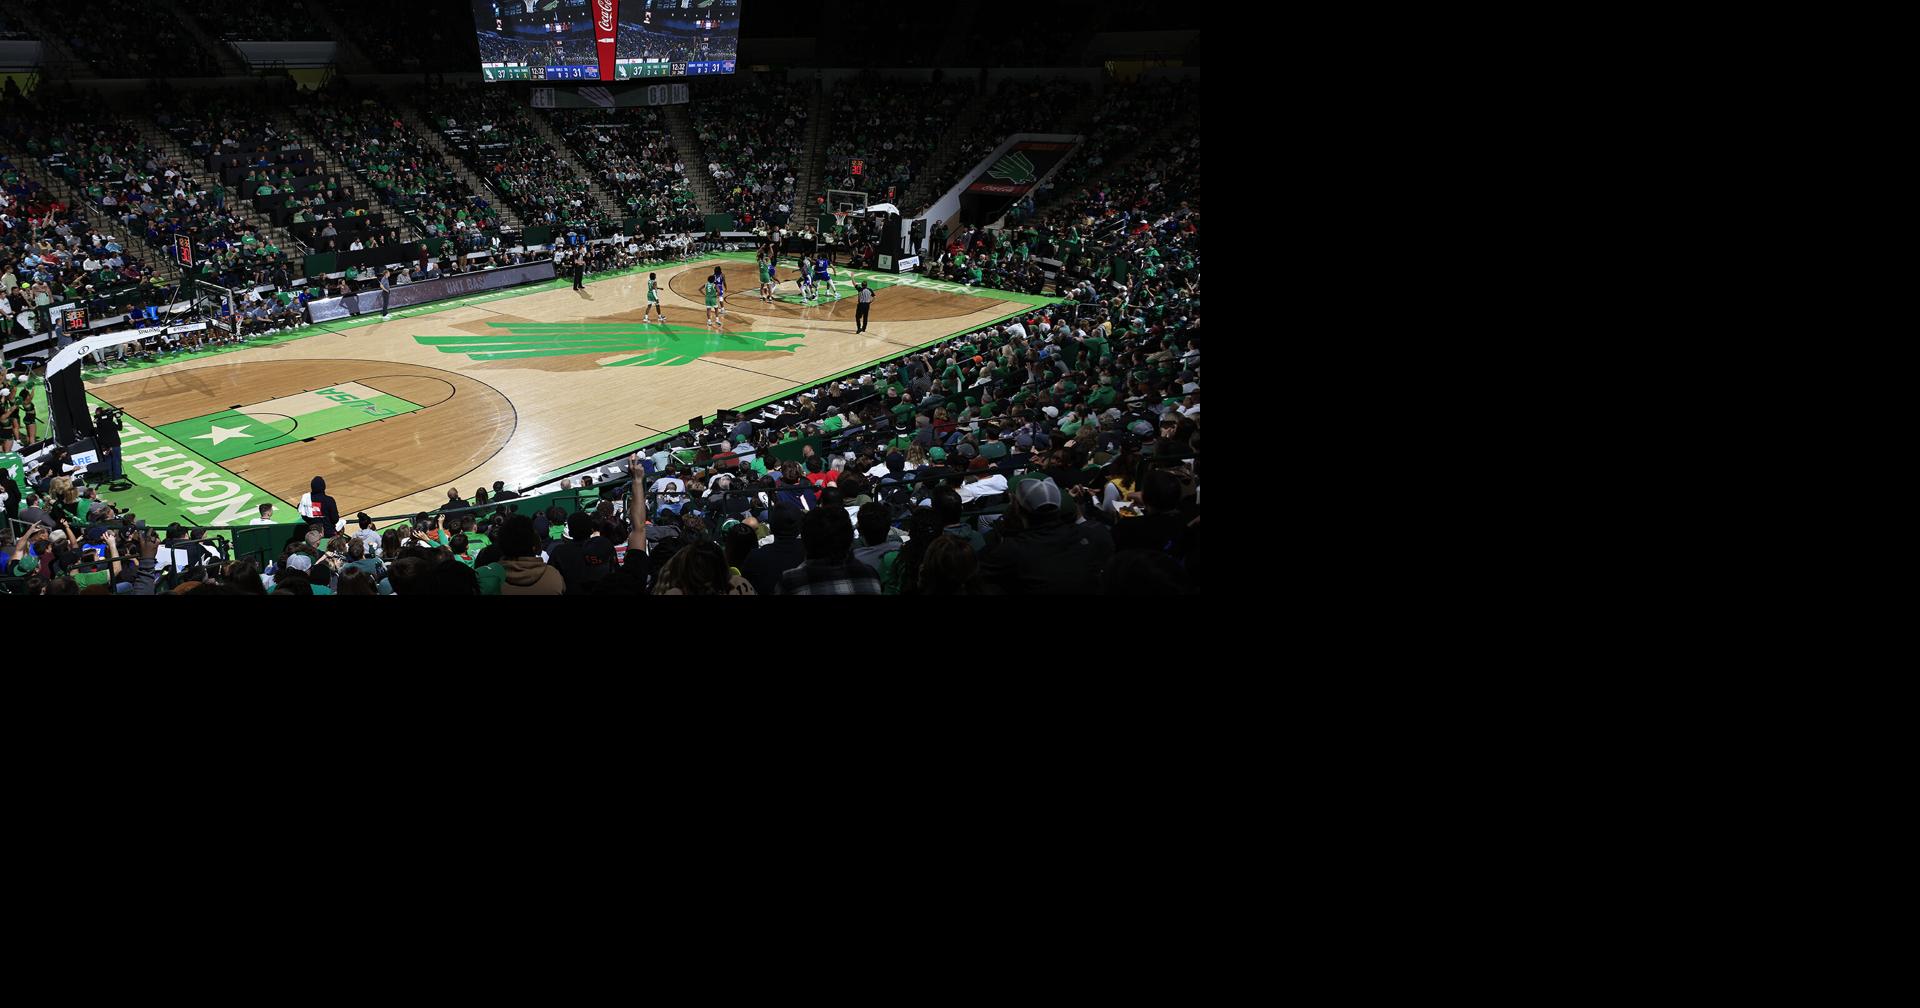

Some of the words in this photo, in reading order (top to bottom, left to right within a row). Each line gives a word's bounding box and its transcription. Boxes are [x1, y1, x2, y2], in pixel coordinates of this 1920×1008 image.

[598, 0, 613, 32] Coca-Co
[572, 68, 582, 77] 31
[633, 66, 643, 76] 37
[672, 63, 685, 71] 12:32
[712, 63, 720, 72] 31
[497, 69, 506, 79] 37
[648, 84, 668, 106] GO
[446, 280, 465, 295] UNT
[867, 273, 988, 294] GREEN
[122, 446, 280, 527] NORTH
